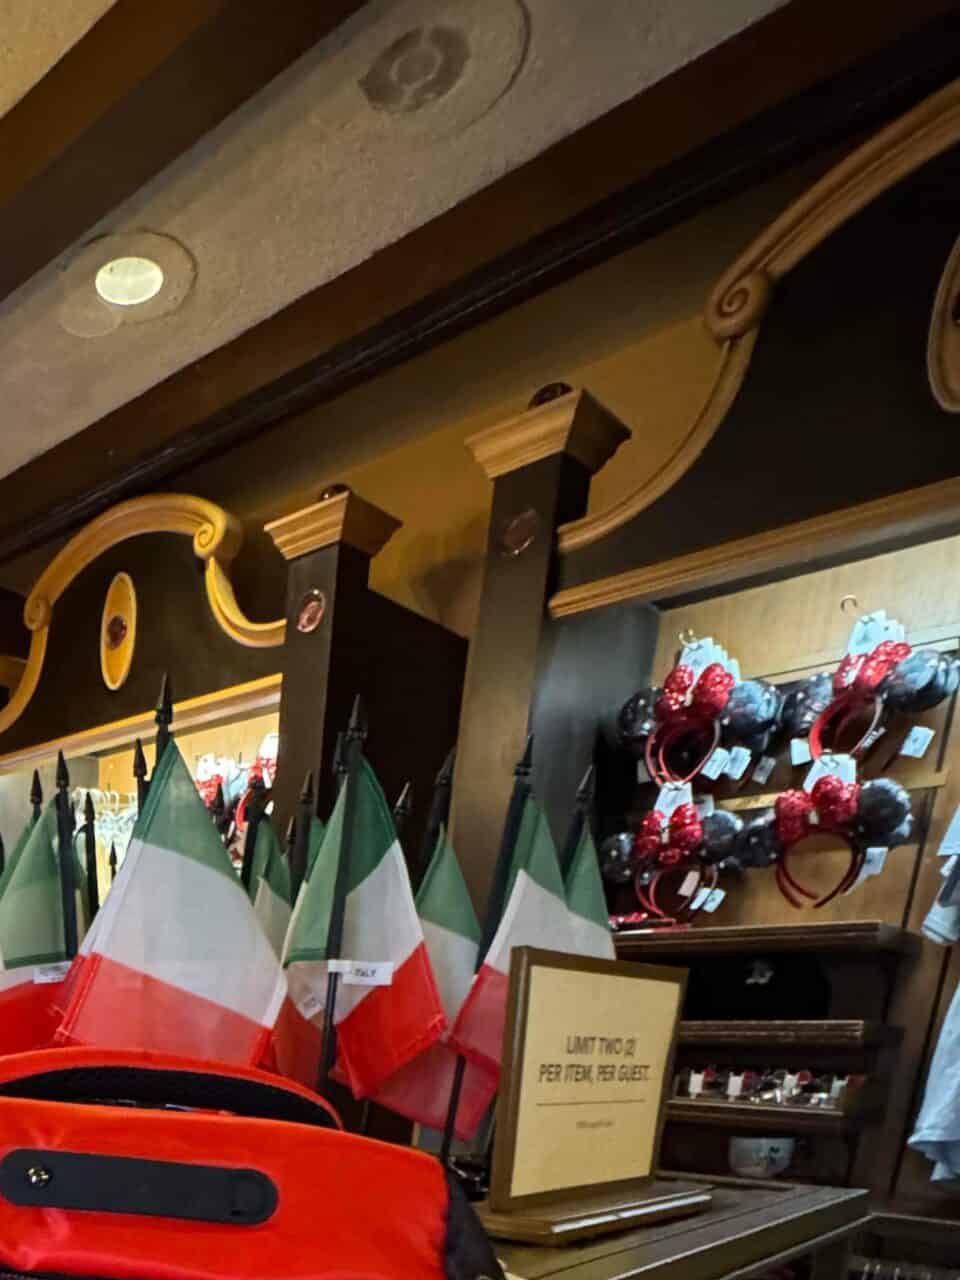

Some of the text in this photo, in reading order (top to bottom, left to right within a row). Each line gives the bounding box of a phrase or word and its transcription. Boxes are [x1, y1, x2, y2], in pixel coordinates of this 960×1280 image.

[566, 1036, 596, 1055] LIMIT
[599, 1037, 623, 1055] TWO
[538, 1063, 562, 1083] PER
[597, 1064, 617, 1082] PER
